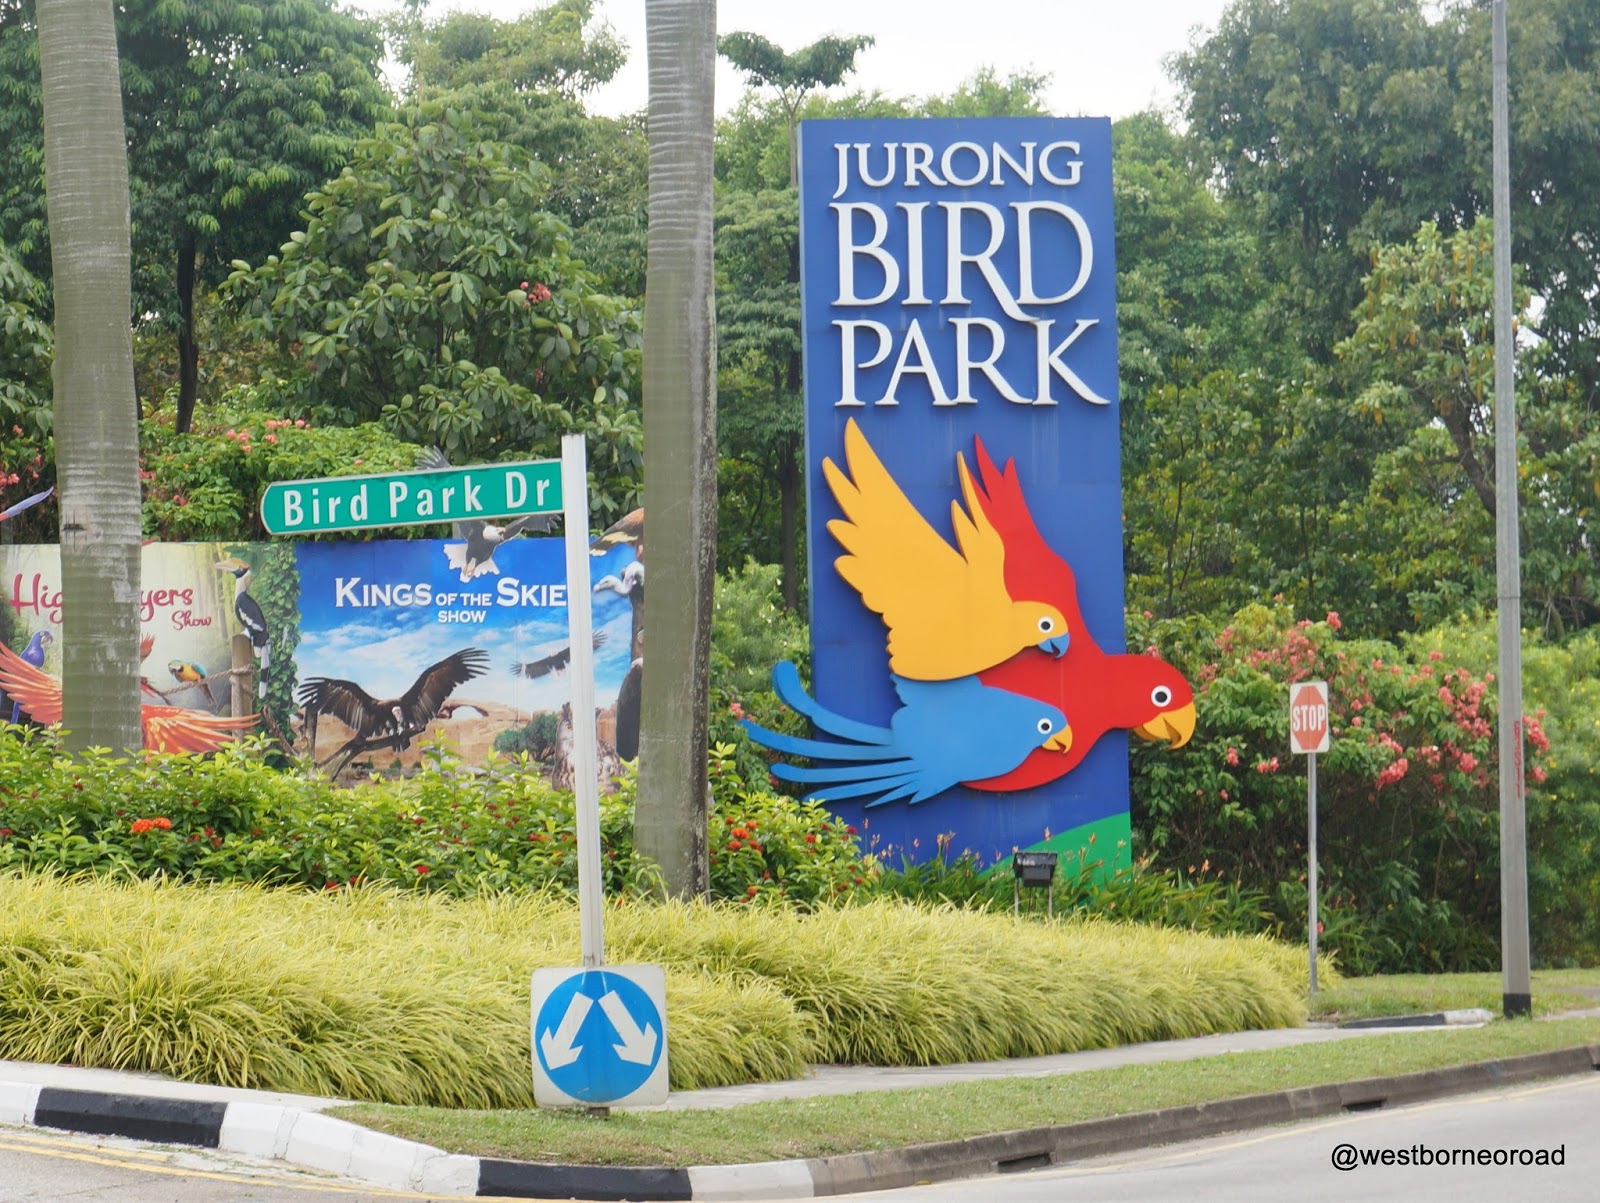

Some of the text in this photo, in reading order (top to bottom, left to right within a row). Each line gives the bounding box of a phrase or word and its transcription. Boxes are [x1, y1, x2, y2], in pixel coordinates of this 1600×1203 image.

[832, 141, 1084, 199] JURONG
[828, 200, 1094, 322] BIRD
[831, 317, 1111, 406] PARK
[284, 470, 550, 527] Bird Park Dr
[9, 573, 194, 624] Hig yers
[335, 577, 567, 608] KINGS OF THE SKIE
[438, 610, 487, 624] SHOW
[171, 610, 212, 631] Show
[1293, 703, 1326, 732] STOP
